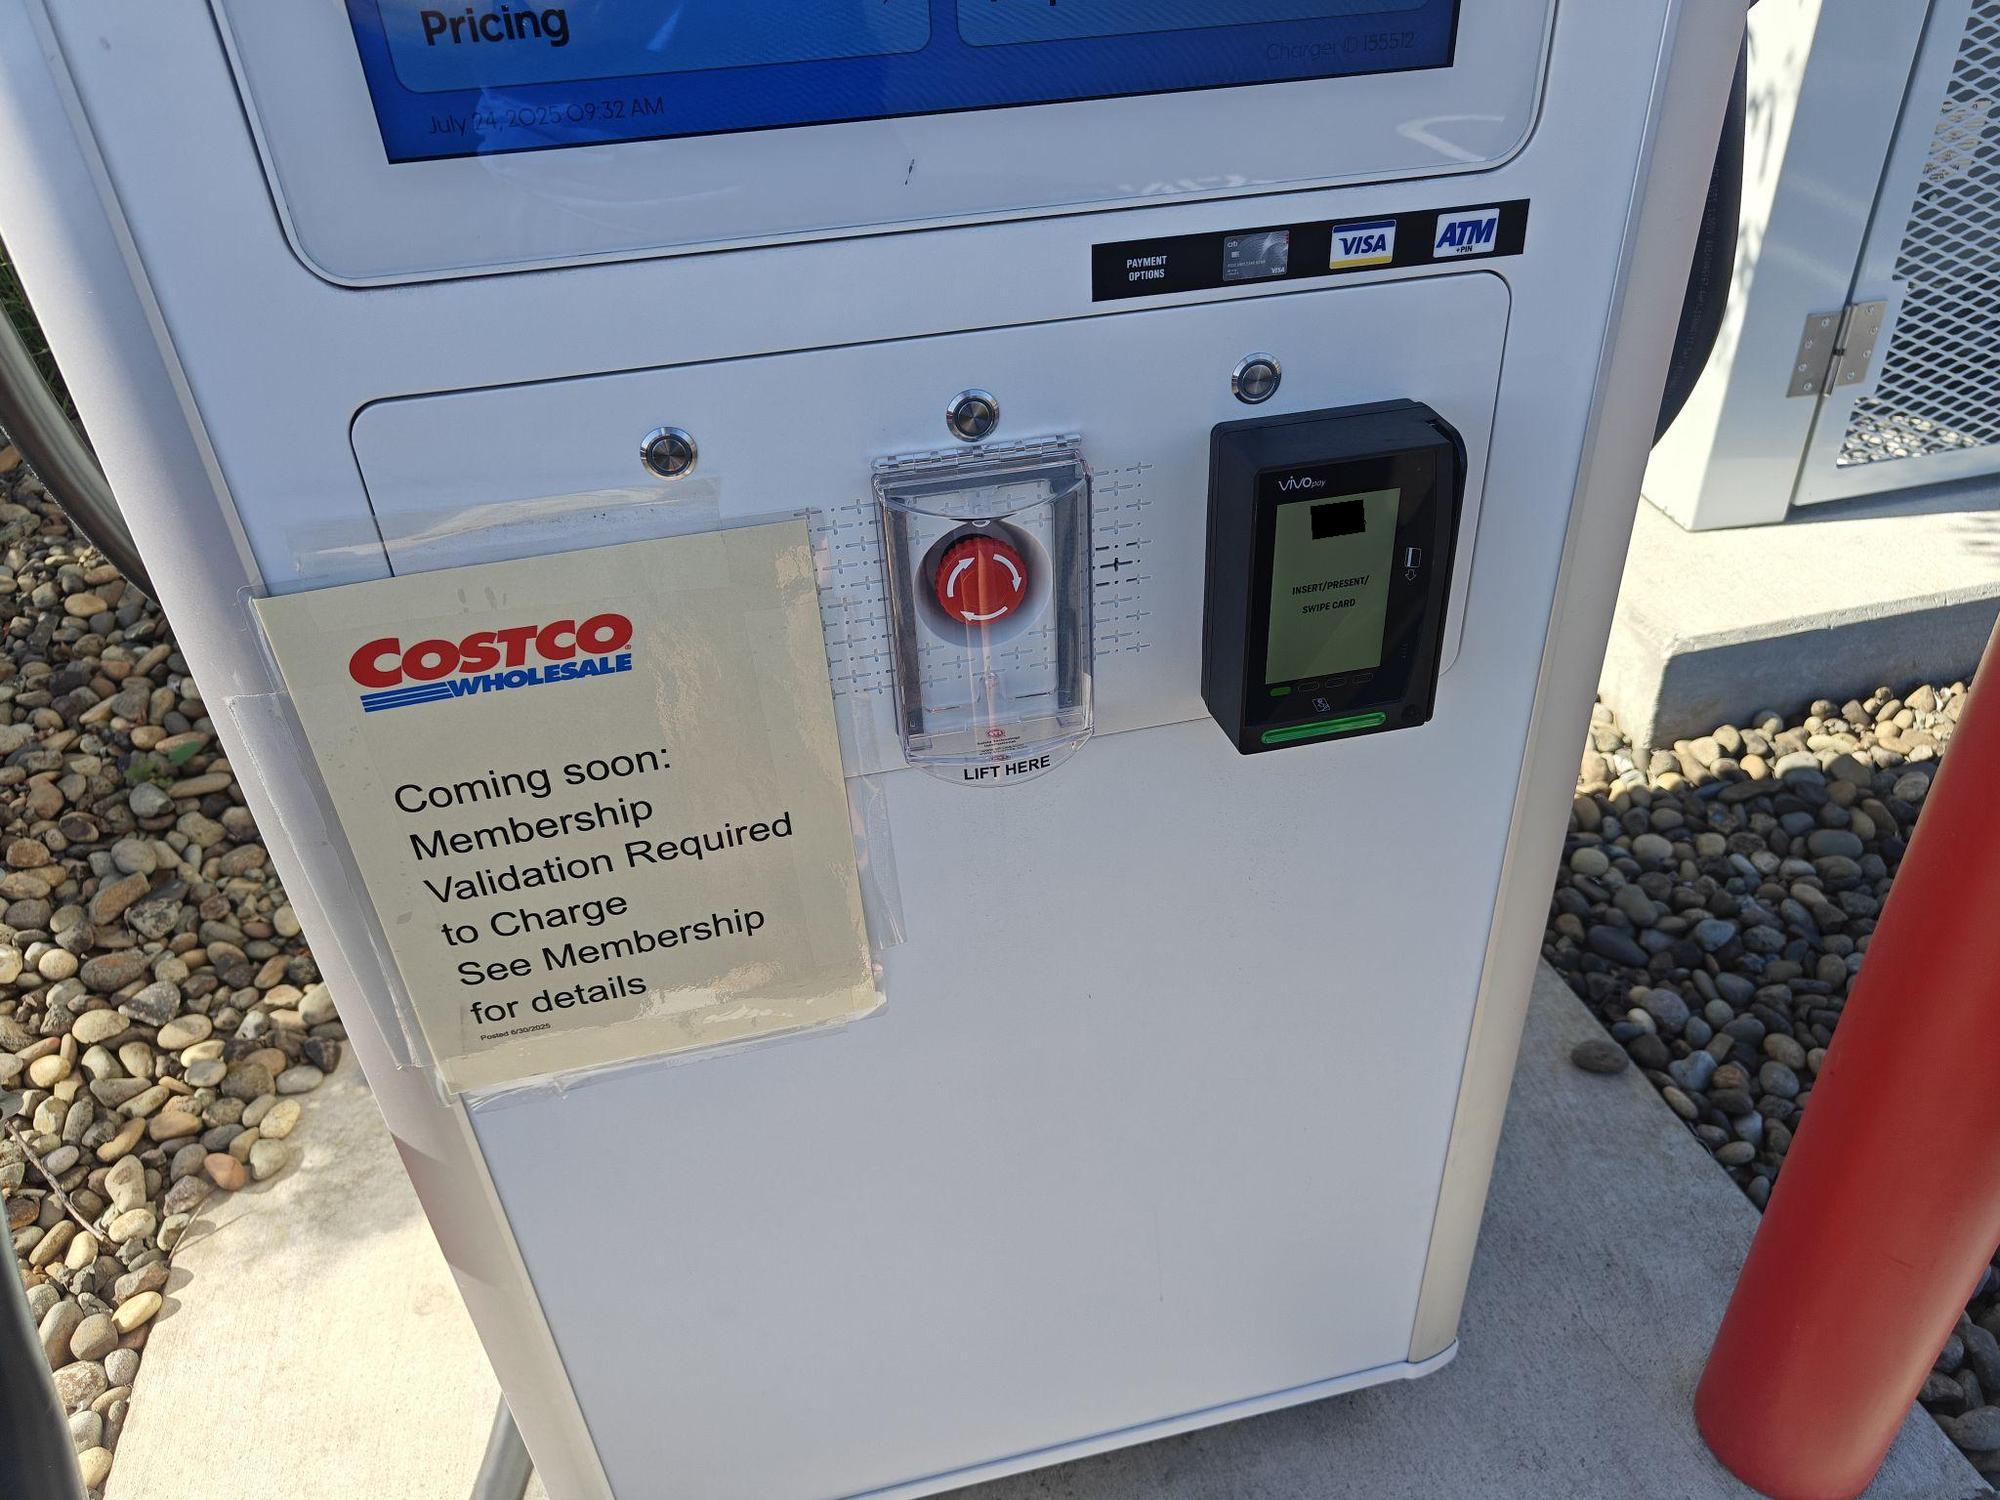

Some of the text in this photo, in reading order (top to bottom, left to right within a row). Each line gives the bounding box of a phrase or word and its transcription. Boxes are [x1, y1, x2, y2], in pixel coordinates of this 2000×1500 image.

[421, 4, 570, 48] Pricing
[430, 115, 466, 136] July
[505, 107, 563, 128] 2025
[631, 96, 664, 117] AM
[1338, 233, 1387, 256] VISA
[1435, 217, 1497, 249] ATM
[1126, 255, 1168, 269] PAYMENT
[1128, 268, 1165, 282] OPTIONS
[1292, 574, 1370, 596] INSERT/PRESENT/
[1302, 598, 1356, 614] SWIPE CARD
[349, 613, 633, 688] COSTCO
[447, 653, 632, 698] WHOLESALE
[394, 748, 671, 813] Coming soon:
[963, 754, 1051, 781] LIFT HERE
[409, 797, 653, 861] Membership
[423, 811, 793, 904] Validation Required
[441, 896, 628, 946] to Charge
[457, 908, 765, 986] See Membership
[470, 975, 647, 1025] for details
[480, 1022, 551, 1041] Posted 6/30/2025
